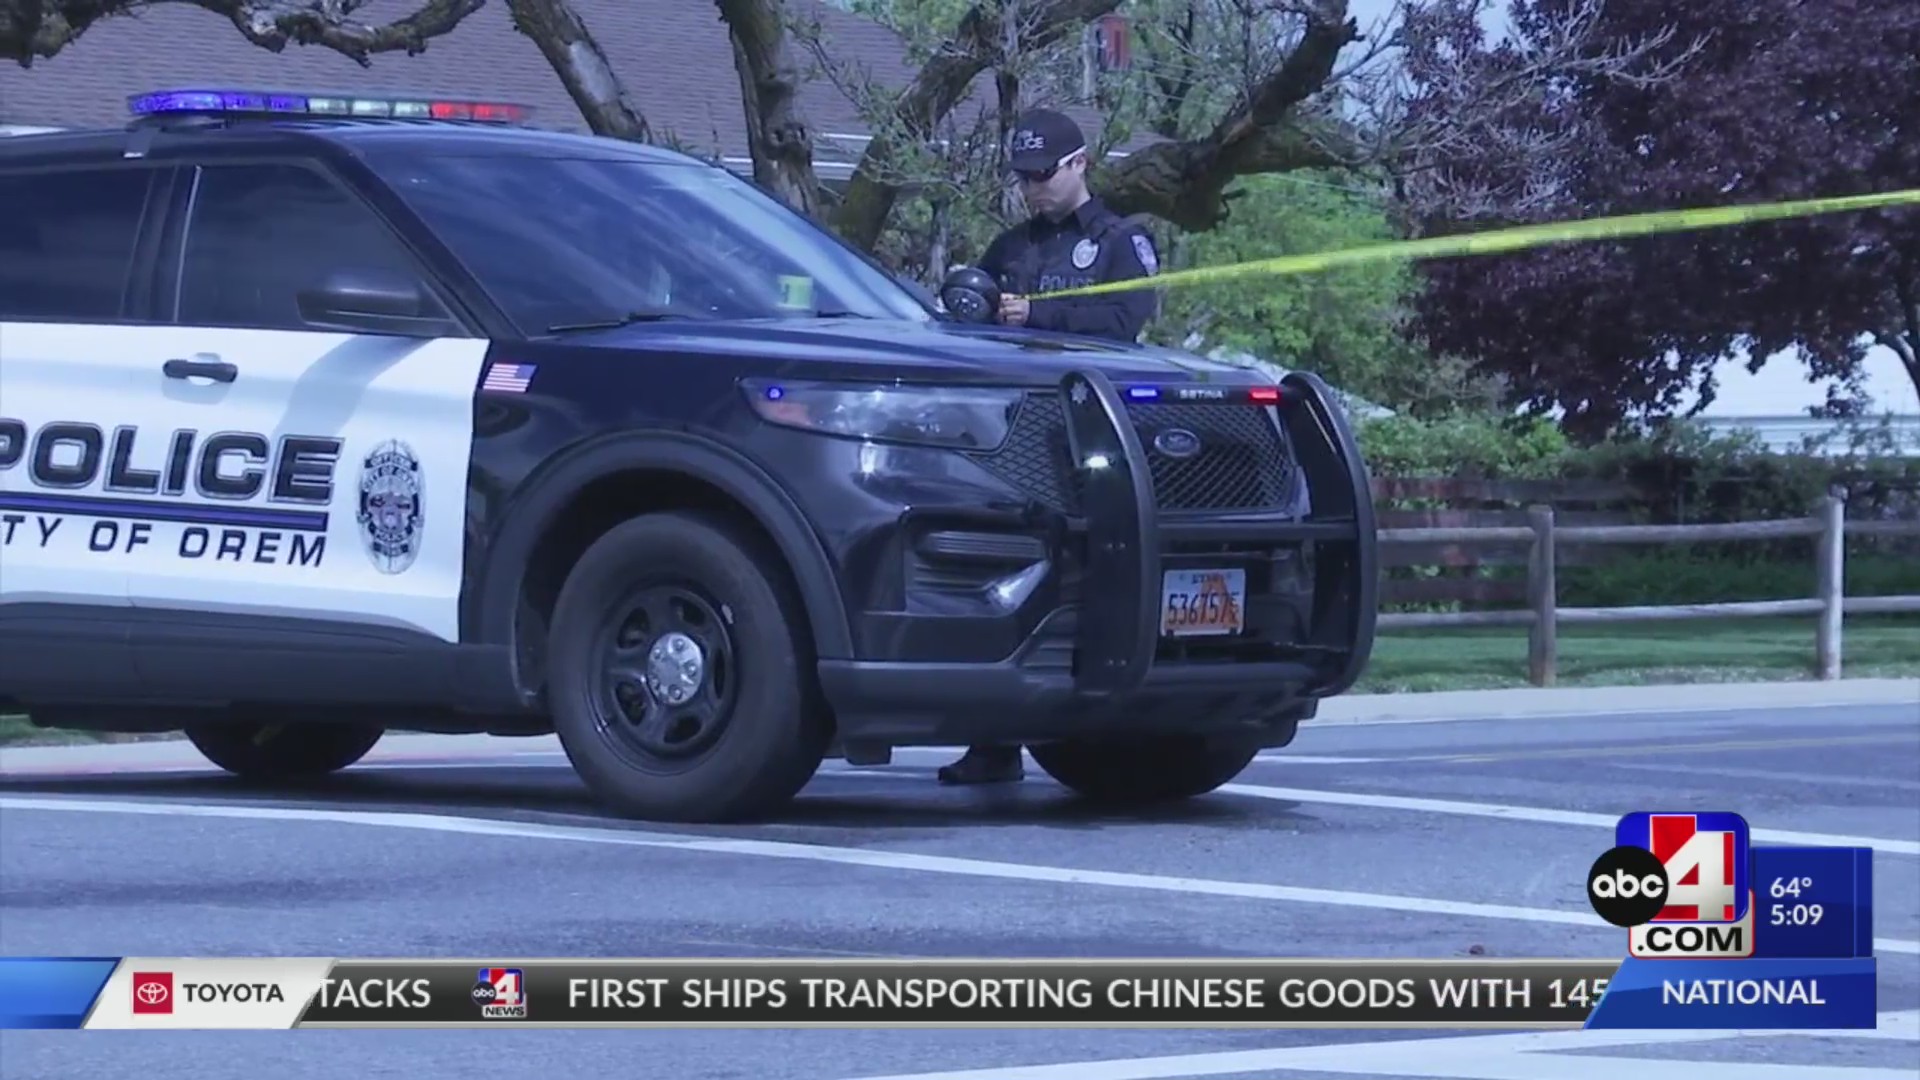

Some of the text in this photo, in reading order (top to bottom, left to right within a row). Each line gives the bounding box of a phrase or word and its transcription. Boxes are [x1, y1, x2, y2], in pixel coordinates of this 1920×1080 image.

[0, 514, 327, 568] TY OF OREM
